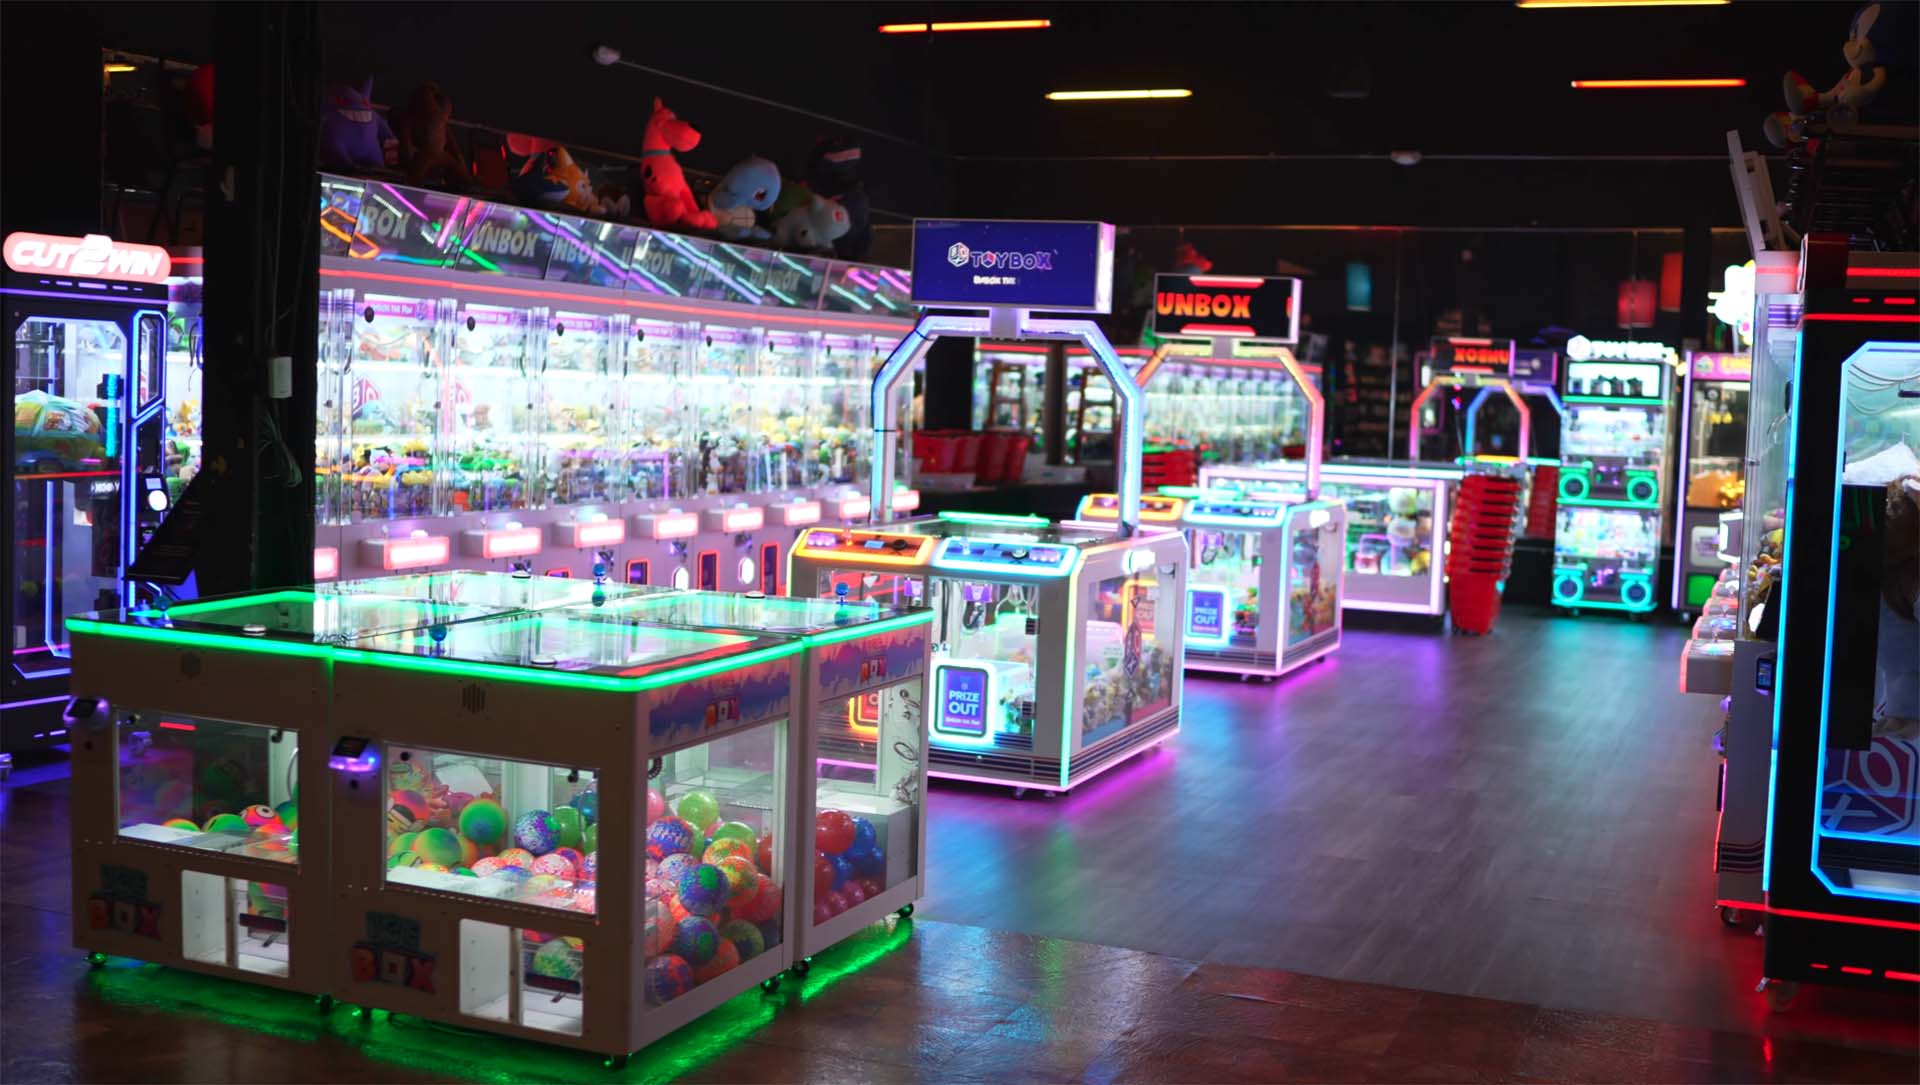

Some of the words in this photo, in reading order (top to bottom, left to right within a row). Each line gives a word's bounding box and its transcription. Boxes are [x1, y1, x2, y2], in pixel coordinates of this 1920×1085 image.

[970, 250, 1053, 271] TOYBOX
[1156, 291, 1251, 318] UNBOX
[949, 690, 980, 703] PRIZE
[948, 701, 979, 716] OUT
